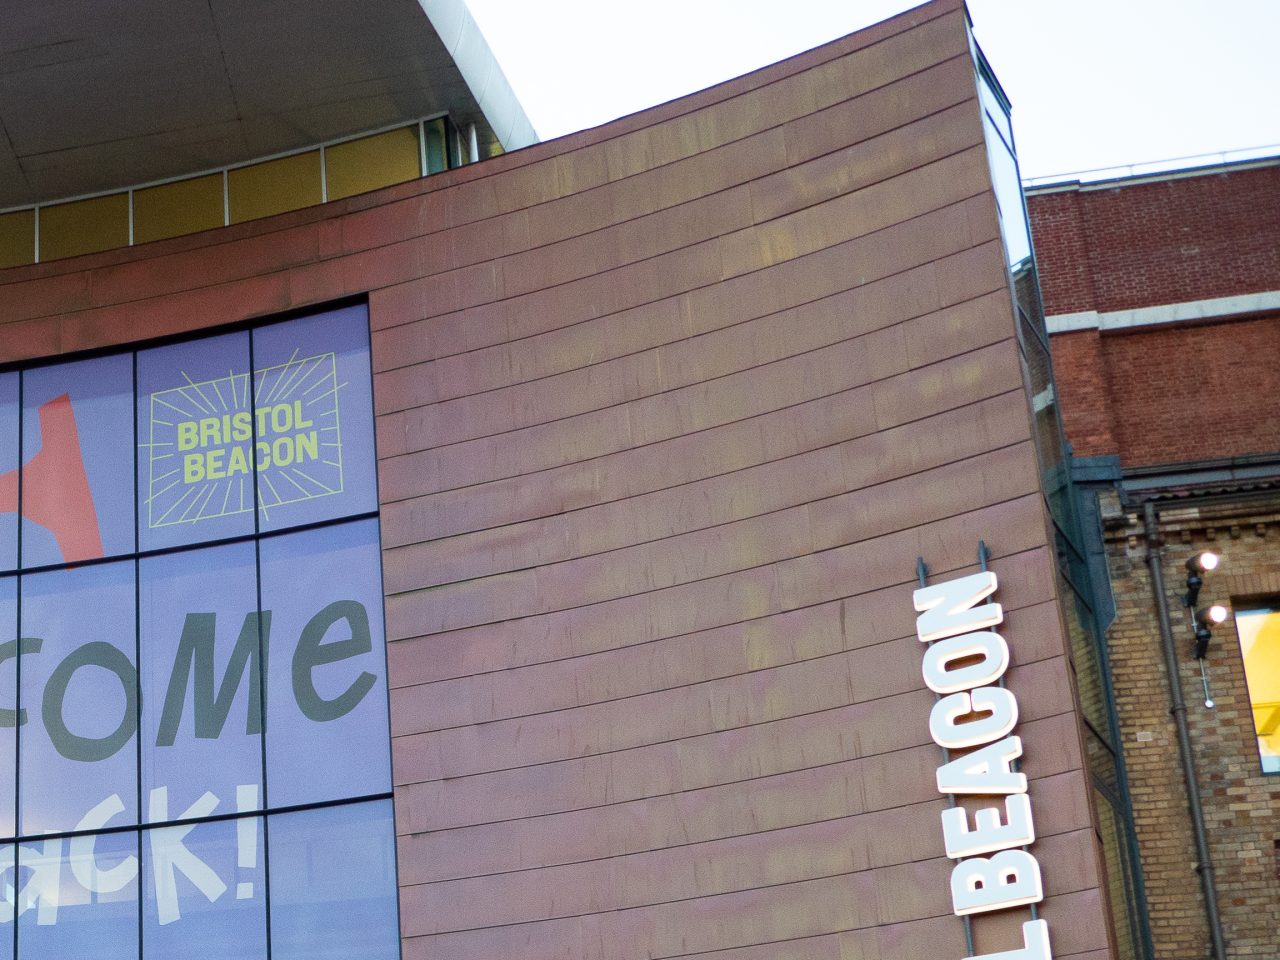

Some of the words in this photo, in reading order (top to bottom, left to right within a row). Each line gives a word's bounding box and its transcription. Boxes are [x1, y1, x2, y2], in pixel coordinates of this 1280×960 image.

[178, 400, 313, 451] BRISTOL
[184, 411, 318, 484] BEACON
[913, 570, 1044, 917] BEACON
